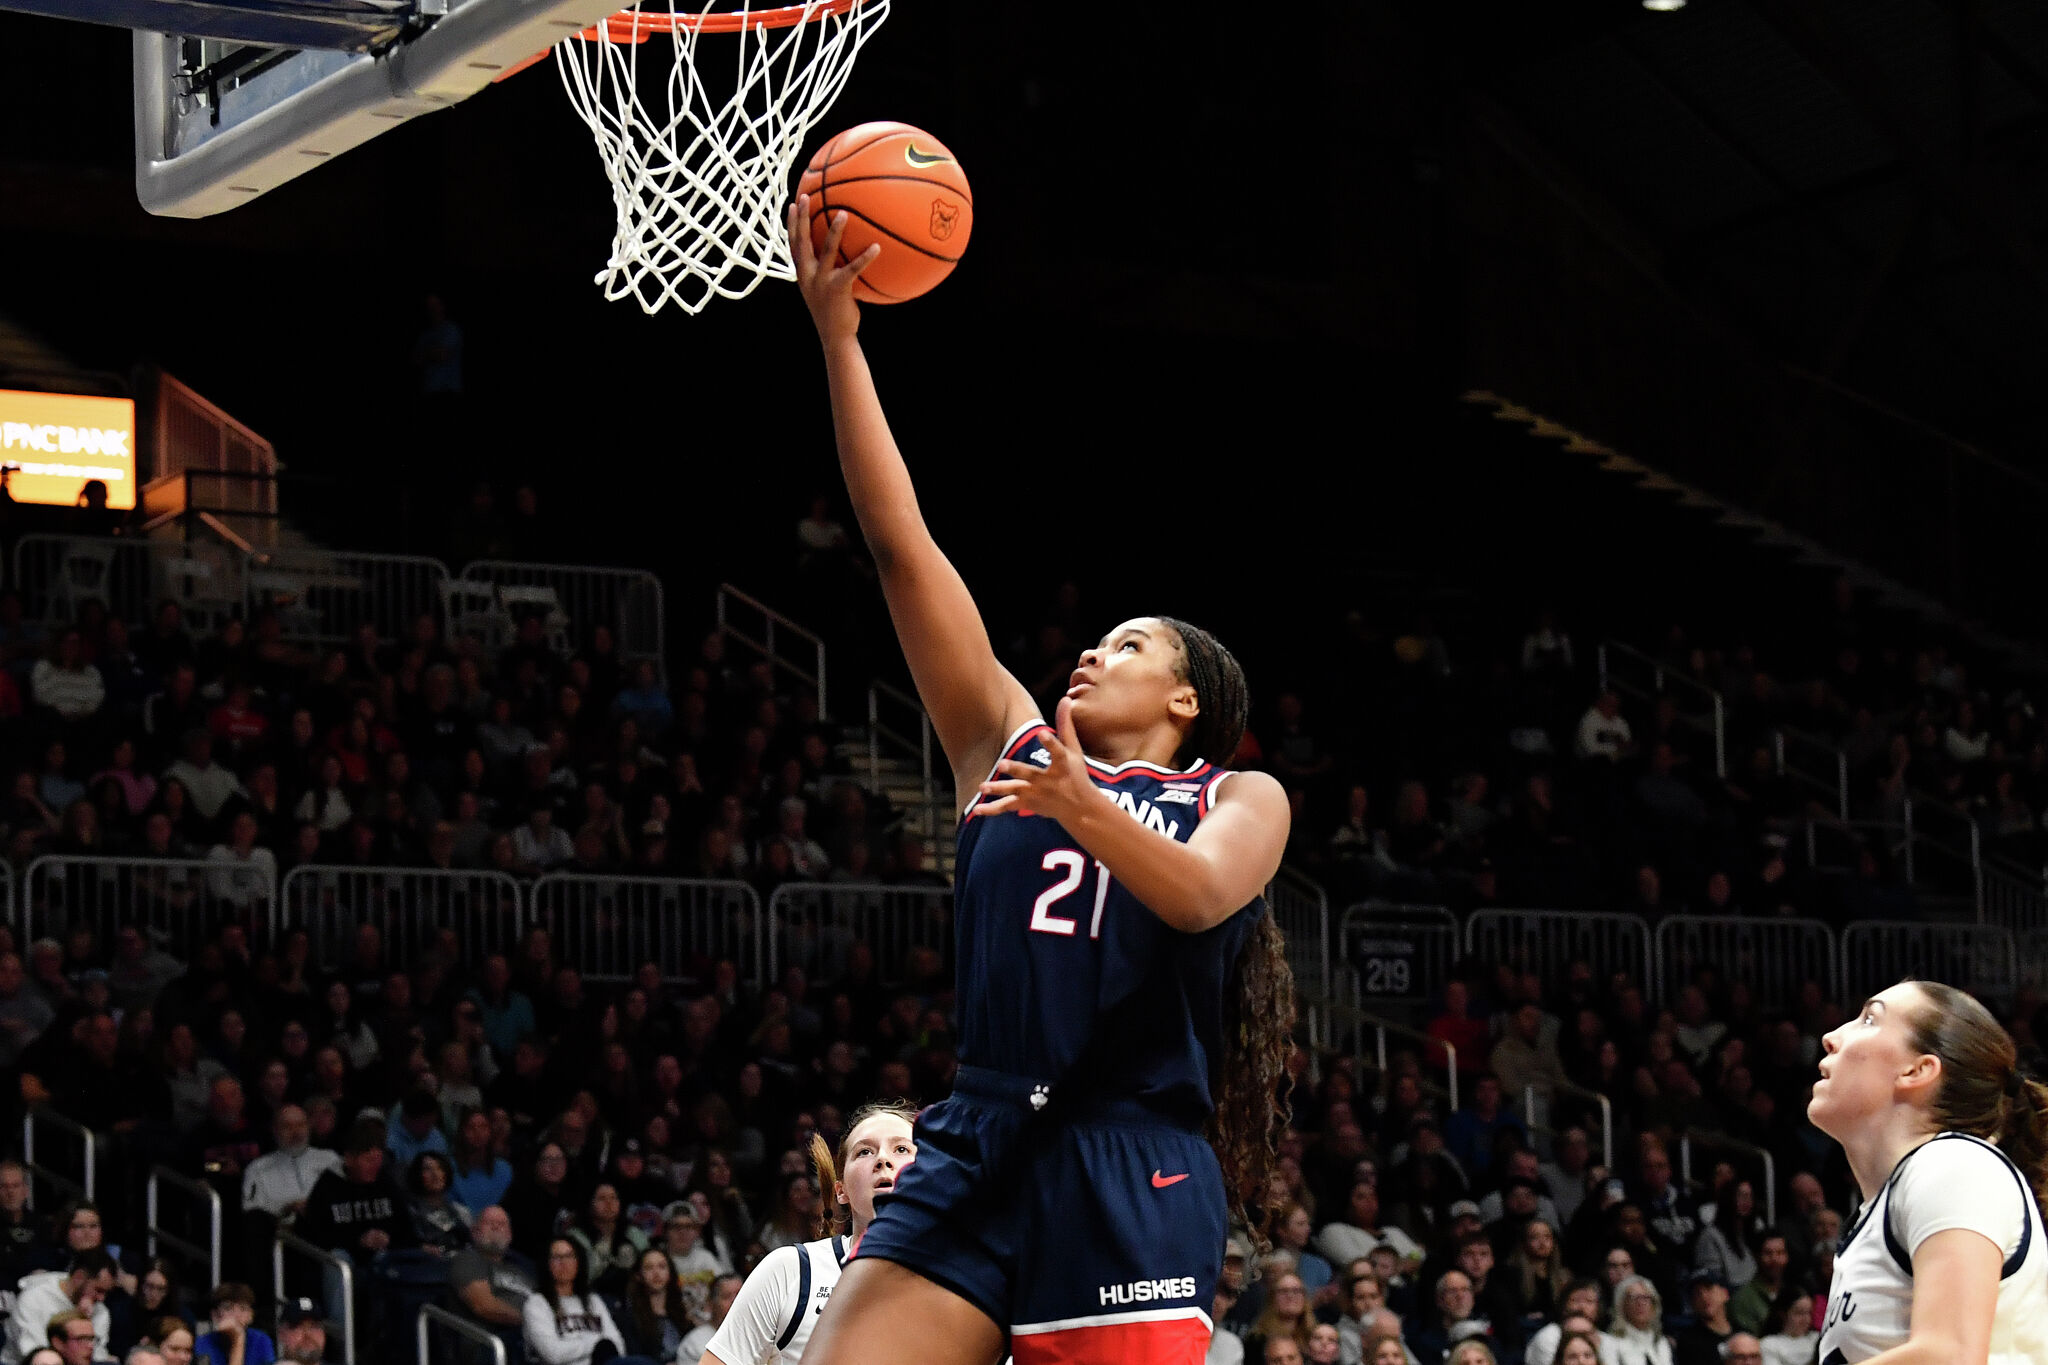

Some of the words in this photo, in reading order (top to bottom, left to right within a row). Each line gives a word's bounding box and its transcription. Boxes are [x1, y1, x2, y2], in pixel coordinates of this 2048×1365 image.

[1029, 848, 1111, 940] 21
[1366, 957, 1410, 993] 219
[1099, 1276, 1196, 1306] HUSKIES
